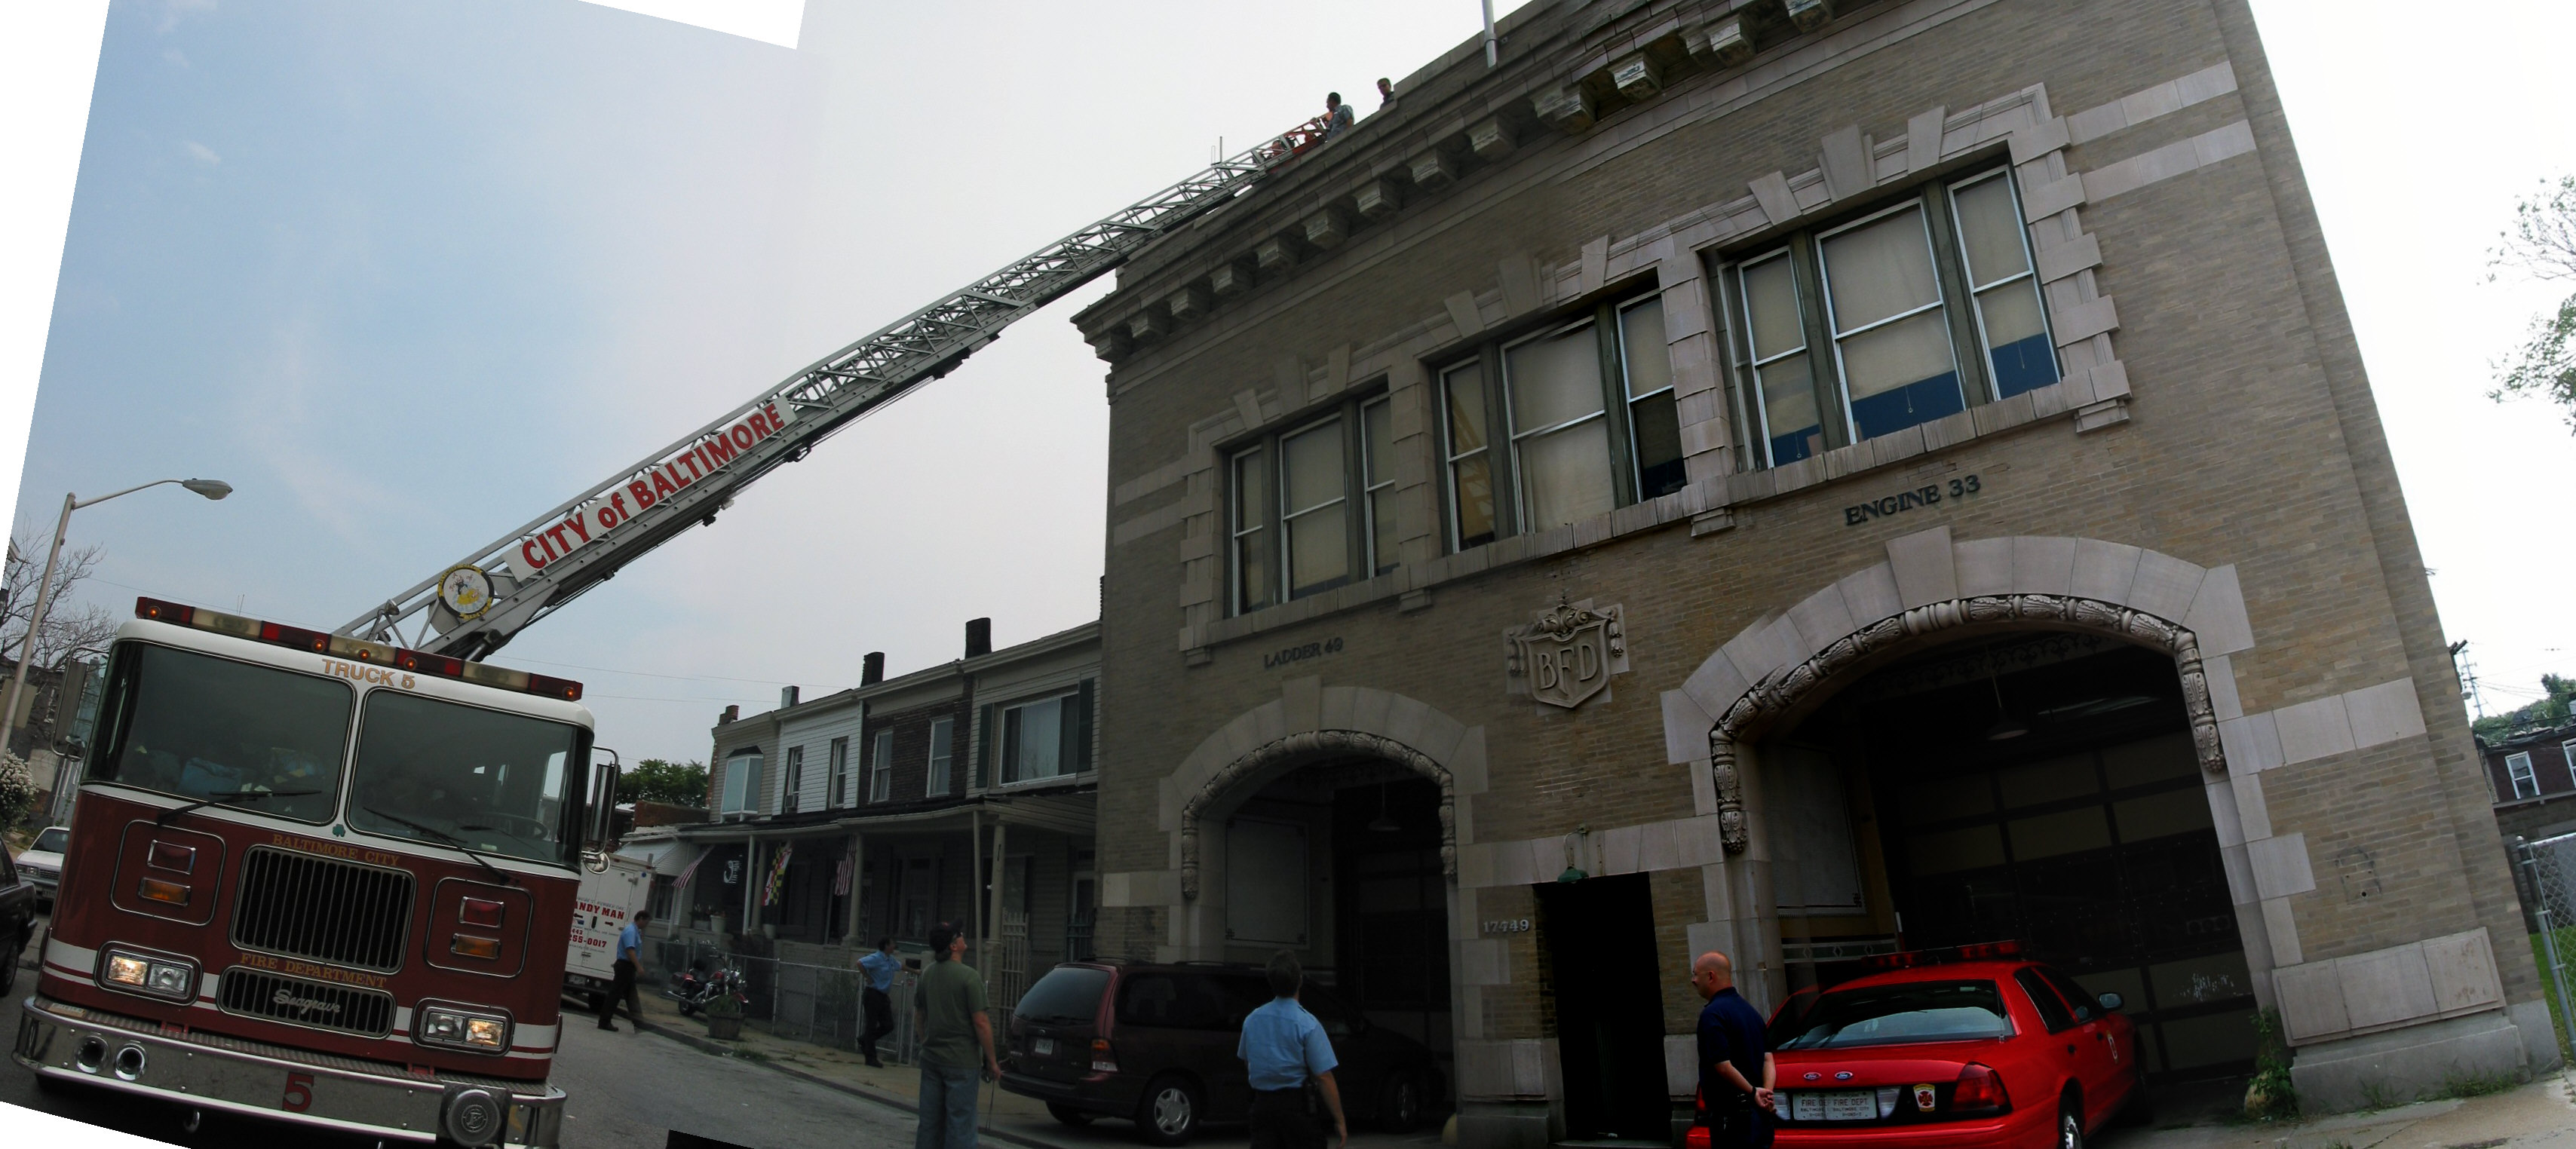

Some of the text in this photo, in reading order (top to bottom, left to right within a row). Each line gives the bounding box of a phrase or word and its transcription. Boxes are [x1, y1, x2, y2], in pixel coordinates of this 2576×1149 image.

[522, 403, 785, 569] CITY of BALTIMORE
[1845, 474, 1981, 525] ENGINE 33
[1264, 642, 1322, 669] LADDER
[1537, 643, 1598, 696] BFD
[322, 658, 416, 689] TRUCK 5
[272, 834, 400, 866] BALTIMORE CITY
[601, 907, 624, 920] MAN
[241, 952, 387, 988] FIRE DEPARTMENT
[273, 989, 341, 1014] Seagrave
[282, 1071, 314, 1112] 5
[1851, 1098, 1868, 1106] DEPT
